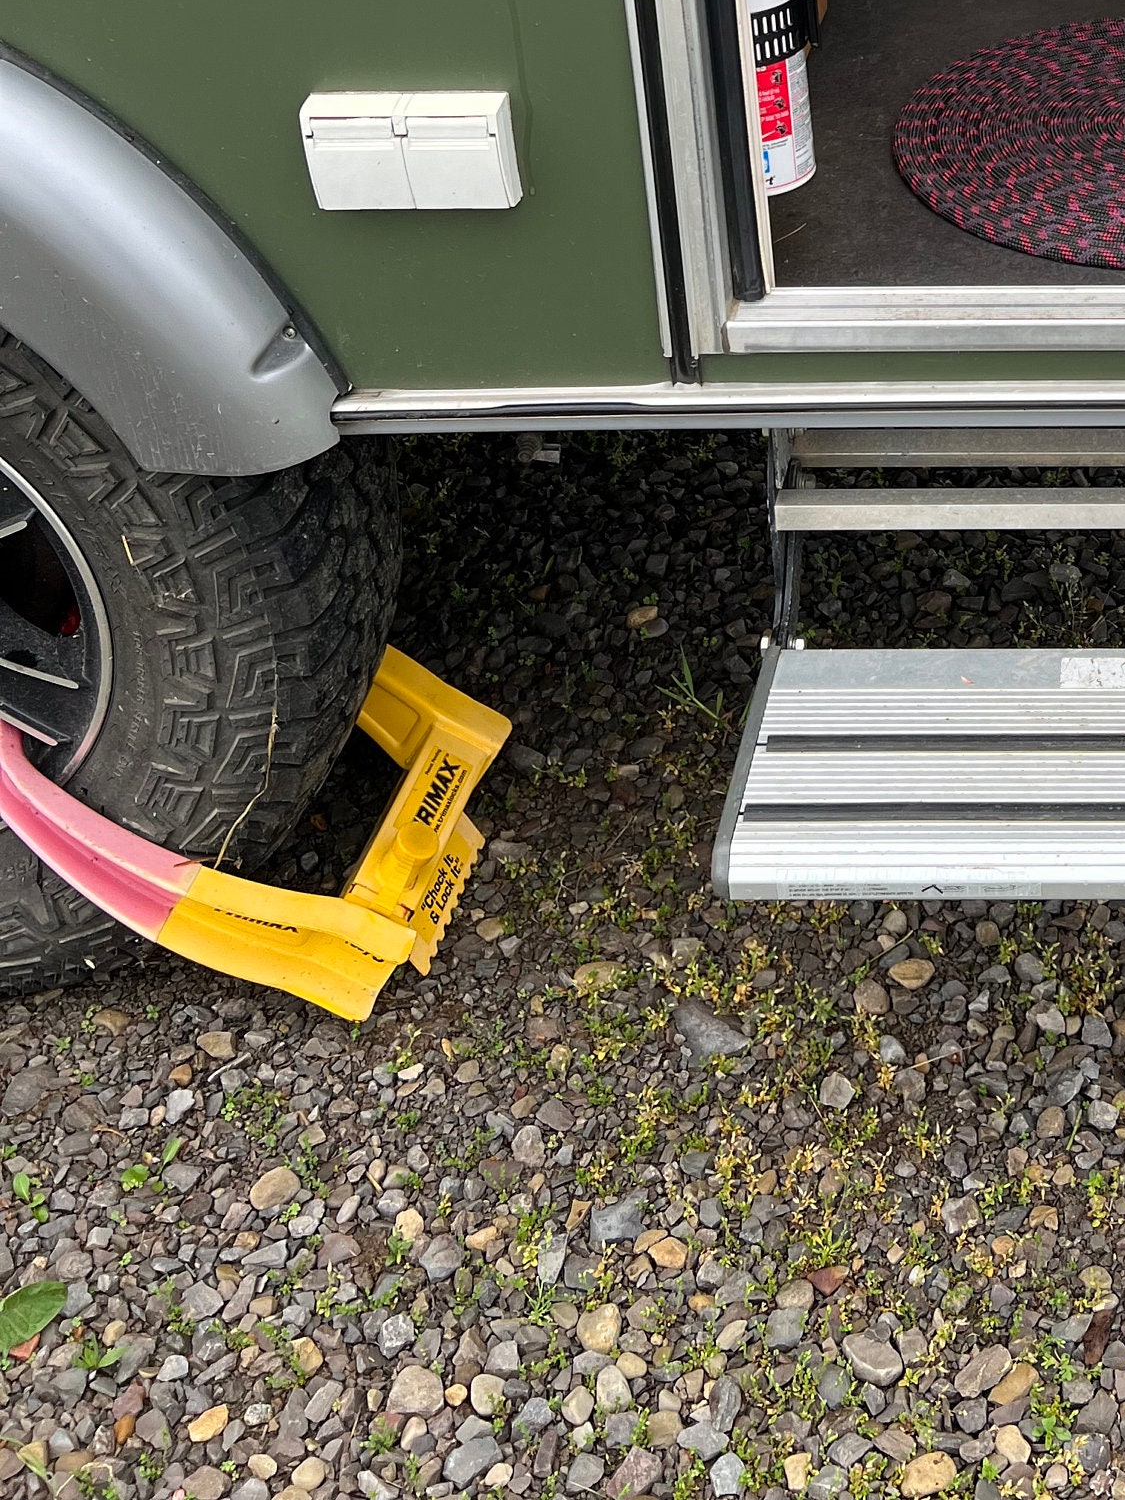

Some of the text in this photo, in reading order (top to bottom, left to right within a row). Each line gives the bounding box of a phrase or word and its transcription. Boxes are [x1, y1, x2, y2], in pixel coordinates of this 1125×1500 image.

[434, 769, 468, 834] w.trimaxlocks.com
[443, 854, 454, 868] It
[430, 910, 440, 925] &
[435, 879, 455, 911] Lock
